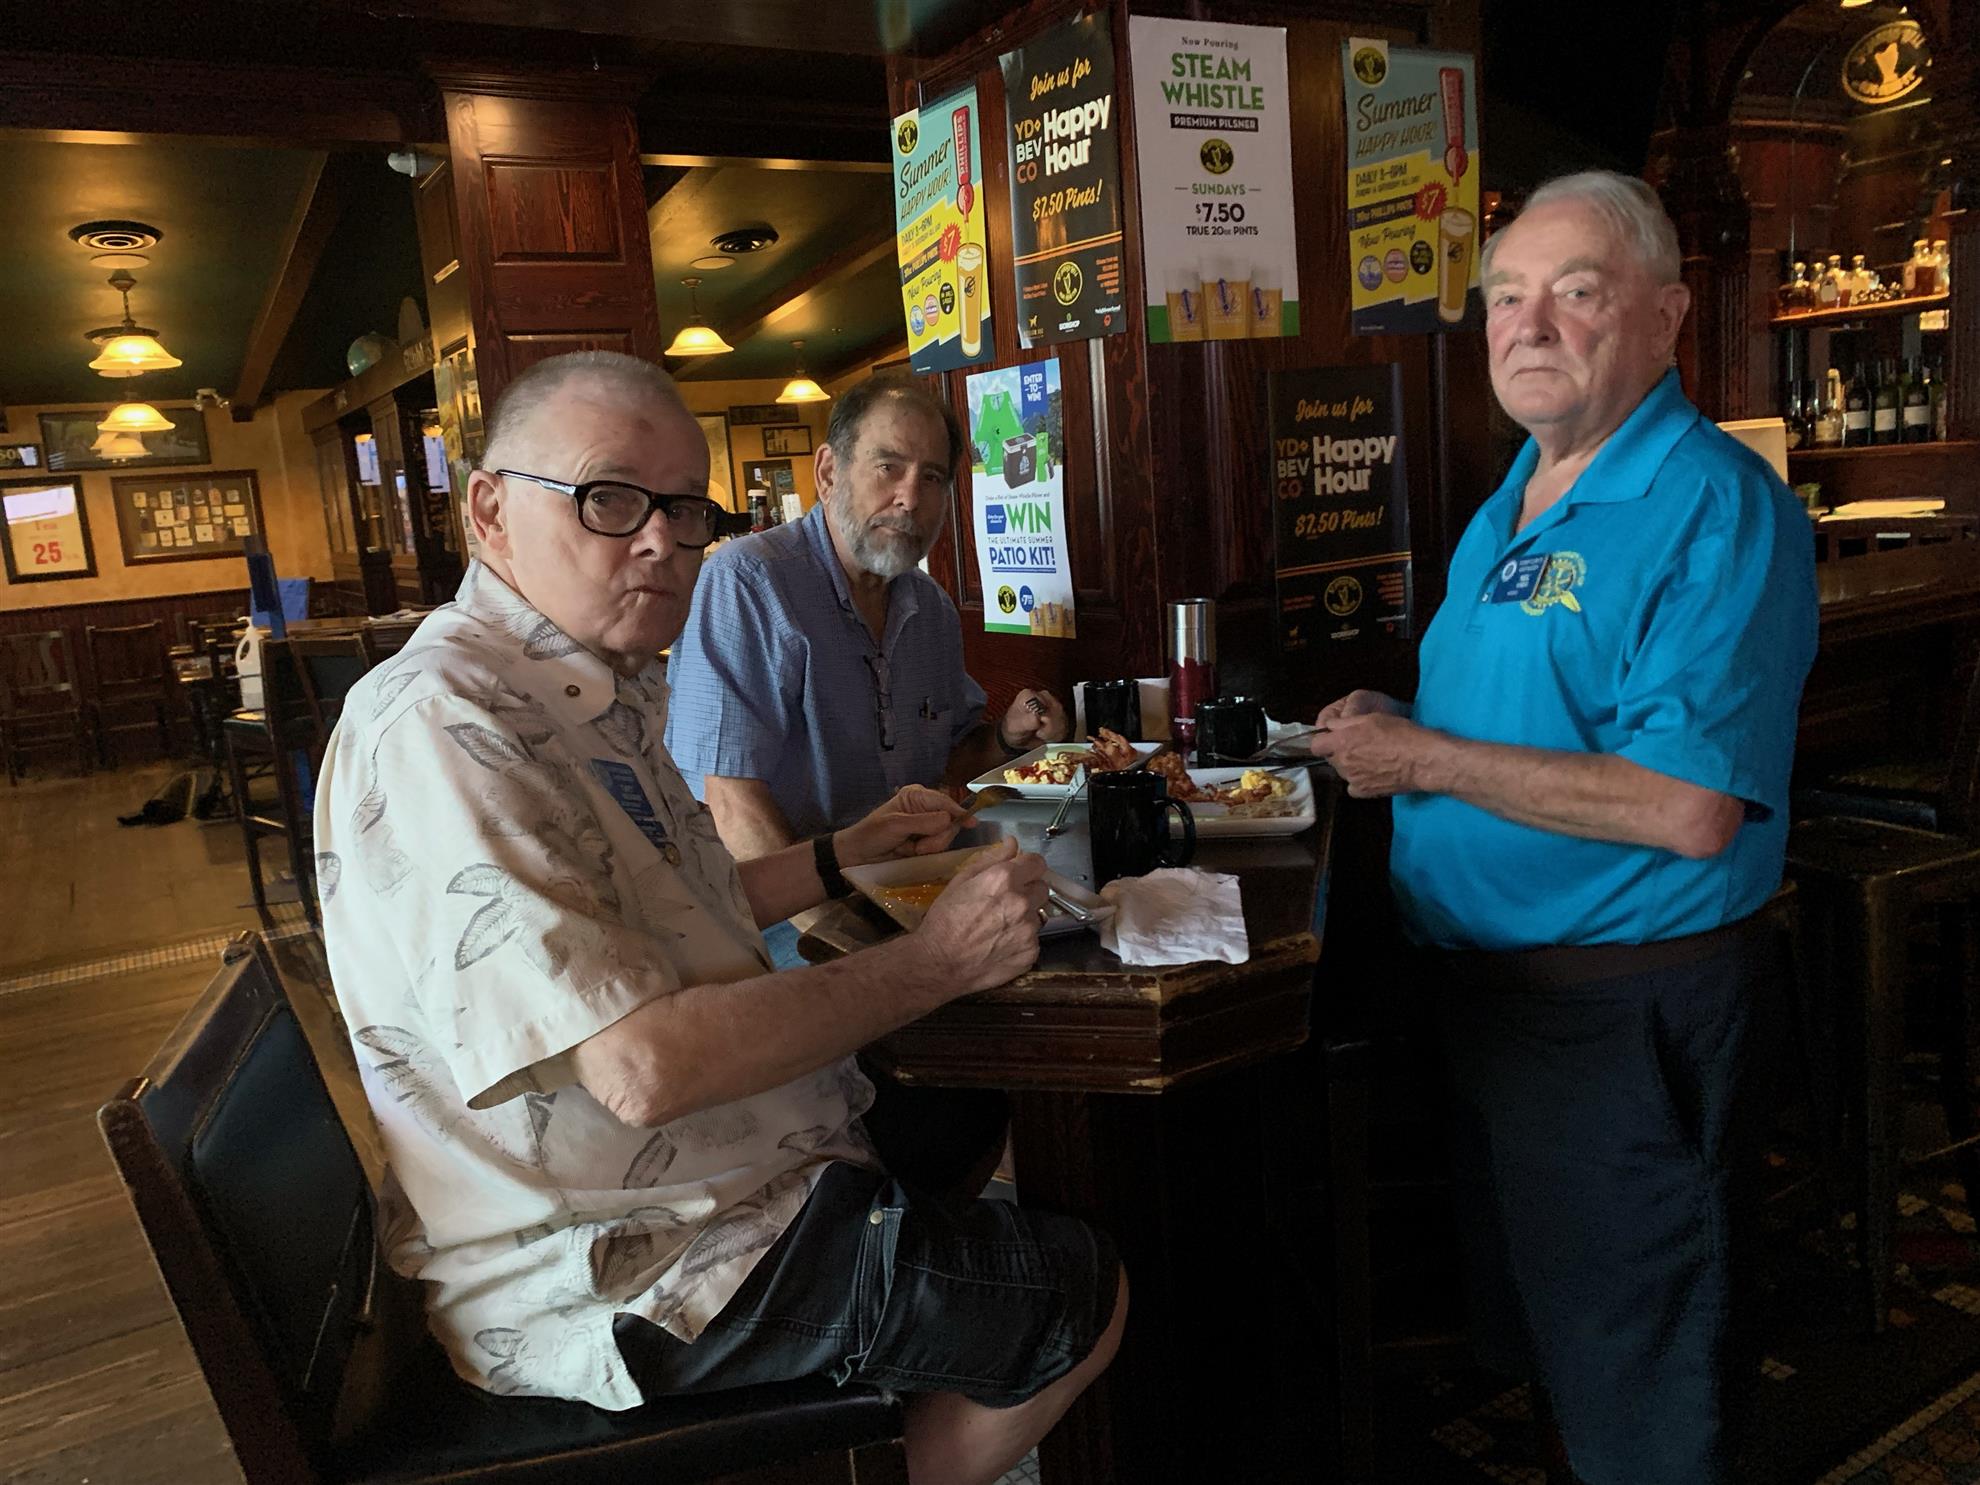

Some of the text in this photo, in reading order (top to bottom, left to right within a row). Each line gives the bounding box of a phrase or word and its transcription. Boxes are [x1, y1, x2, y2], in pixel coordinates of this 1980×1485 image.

[1181, 36, 1239, 50] Now Pouring
[1030, 57, 1092, 101] Join us for
[1171, 53, 1251, 81] STEAM
[1160, 80, 1265, 110] WHISTLE
[1043, 95, 1111, 142] Happy
[1174, 115, 1257, 130] PREMIUM PILSNER
[1356, 91, 1437, 132] Summer
[1015, 136, 1042, 163] BEV
[1045, 138, 1092, 176] Hour
[1355, 131, 1397, 159] HAPPY
[900, 138, 951, 199] Summer
[1017, 162, 1038, 184] CO
[1032, 178, 1103, 222] $7.50 Pints!
[1191, 182, 1247, 196] SUNDAYS
[1422, 188, 1441, 216] $7
[901, 186, 927, 222] HAPPY
[1196, 203, 1245, 223] $7.50
[943, 229, 956, 257] $7
[1186, 226, 1210, 236] TRUE
[1233, 226, 1259, 236] PINTS
[1296, 396, 1374, 423] Join us for
[1312, 435, 1398, 467] Happy
[1277, 457, 1310, 479] BEV
[1314, 466, 1372, 496] Hour
[1278, 479, 1302, 500] CO
[1005, 501, 1052, 533] WIN
[1295, 504, 1384, 537] $7.50 Pints!
[32, 541, 62, 565] 25
[1027, 535, 1053, 544] SUMMER
[989, 546, 1056, 565] PATIO KIT!
